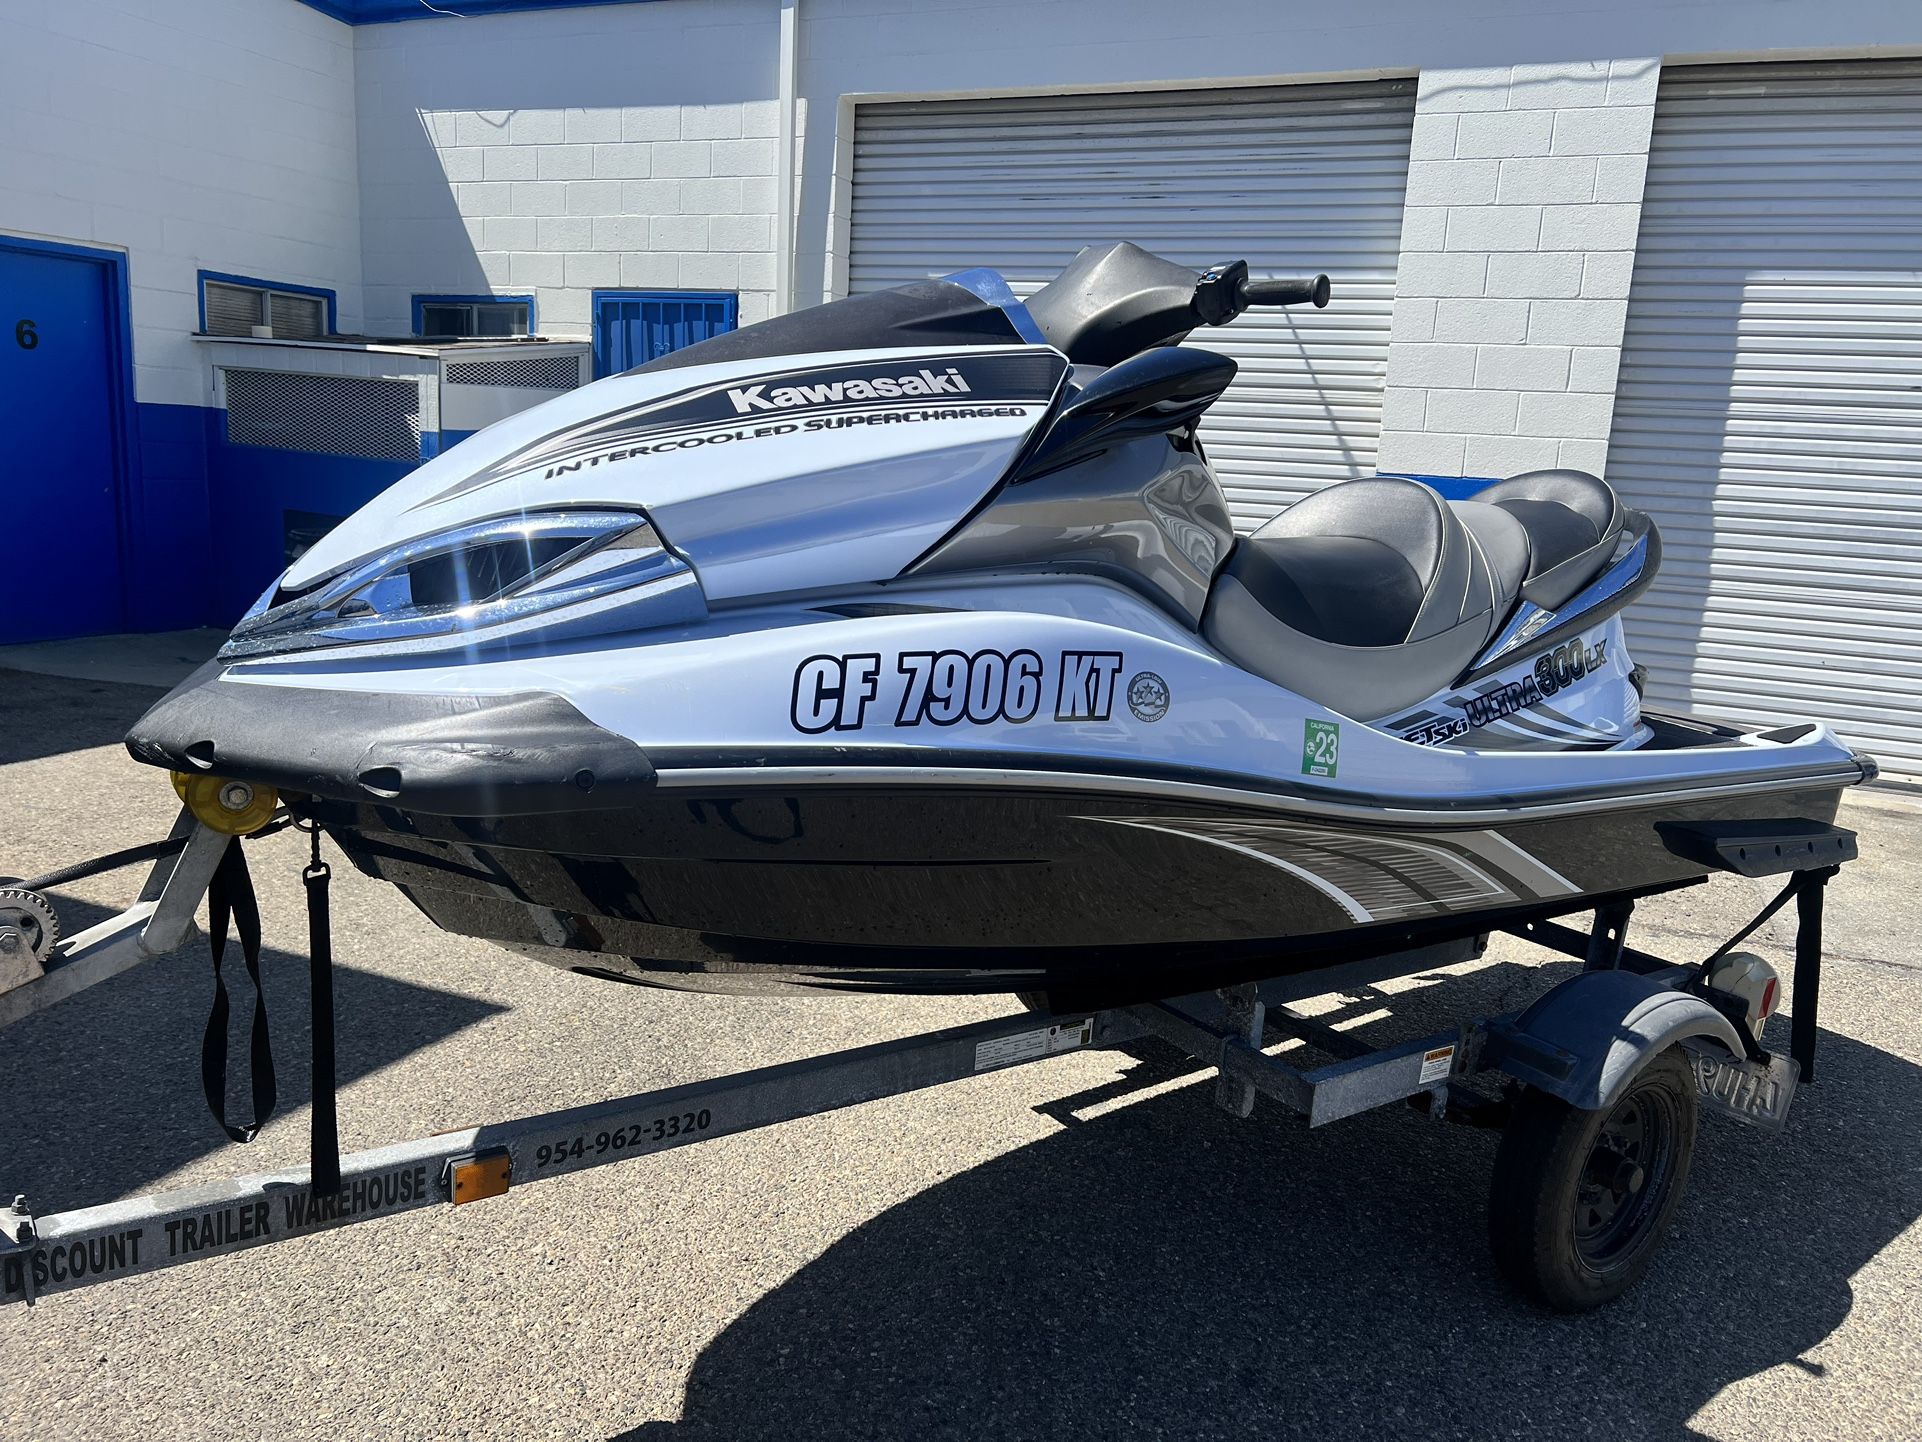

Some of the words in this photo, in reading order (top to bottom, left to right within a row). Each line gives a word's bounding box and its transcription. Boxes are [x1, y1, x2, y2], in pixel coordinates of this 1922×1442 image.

[16, 318, 39, 350] 6
[727, 368, 972, 414] Kawasaki
[544, 423, 799, 480] INTERCOOLED
[803, 407, 1027, 433] SUPERCHARGED
[790, 652, 881, 735] CF
[894, 649, 1043, 727] 7906
[1053, 651, 1124, 722] KT
[1133, 708, 1166, 722] EMISSION
[1464, 674, 1543, 728] ULTRA
[1310, 722, 1334, 731] CALIFORNIA
[1314, 731, 1337, 764] 23
[536, 1108, 711, 1168] 954-962-3320
[4, 1228, 143, 1294] DSCOUNT
[165, 1201, 271, 1257] TRAILER
[285, 1166, 426, 1229] WAREHOUSE
